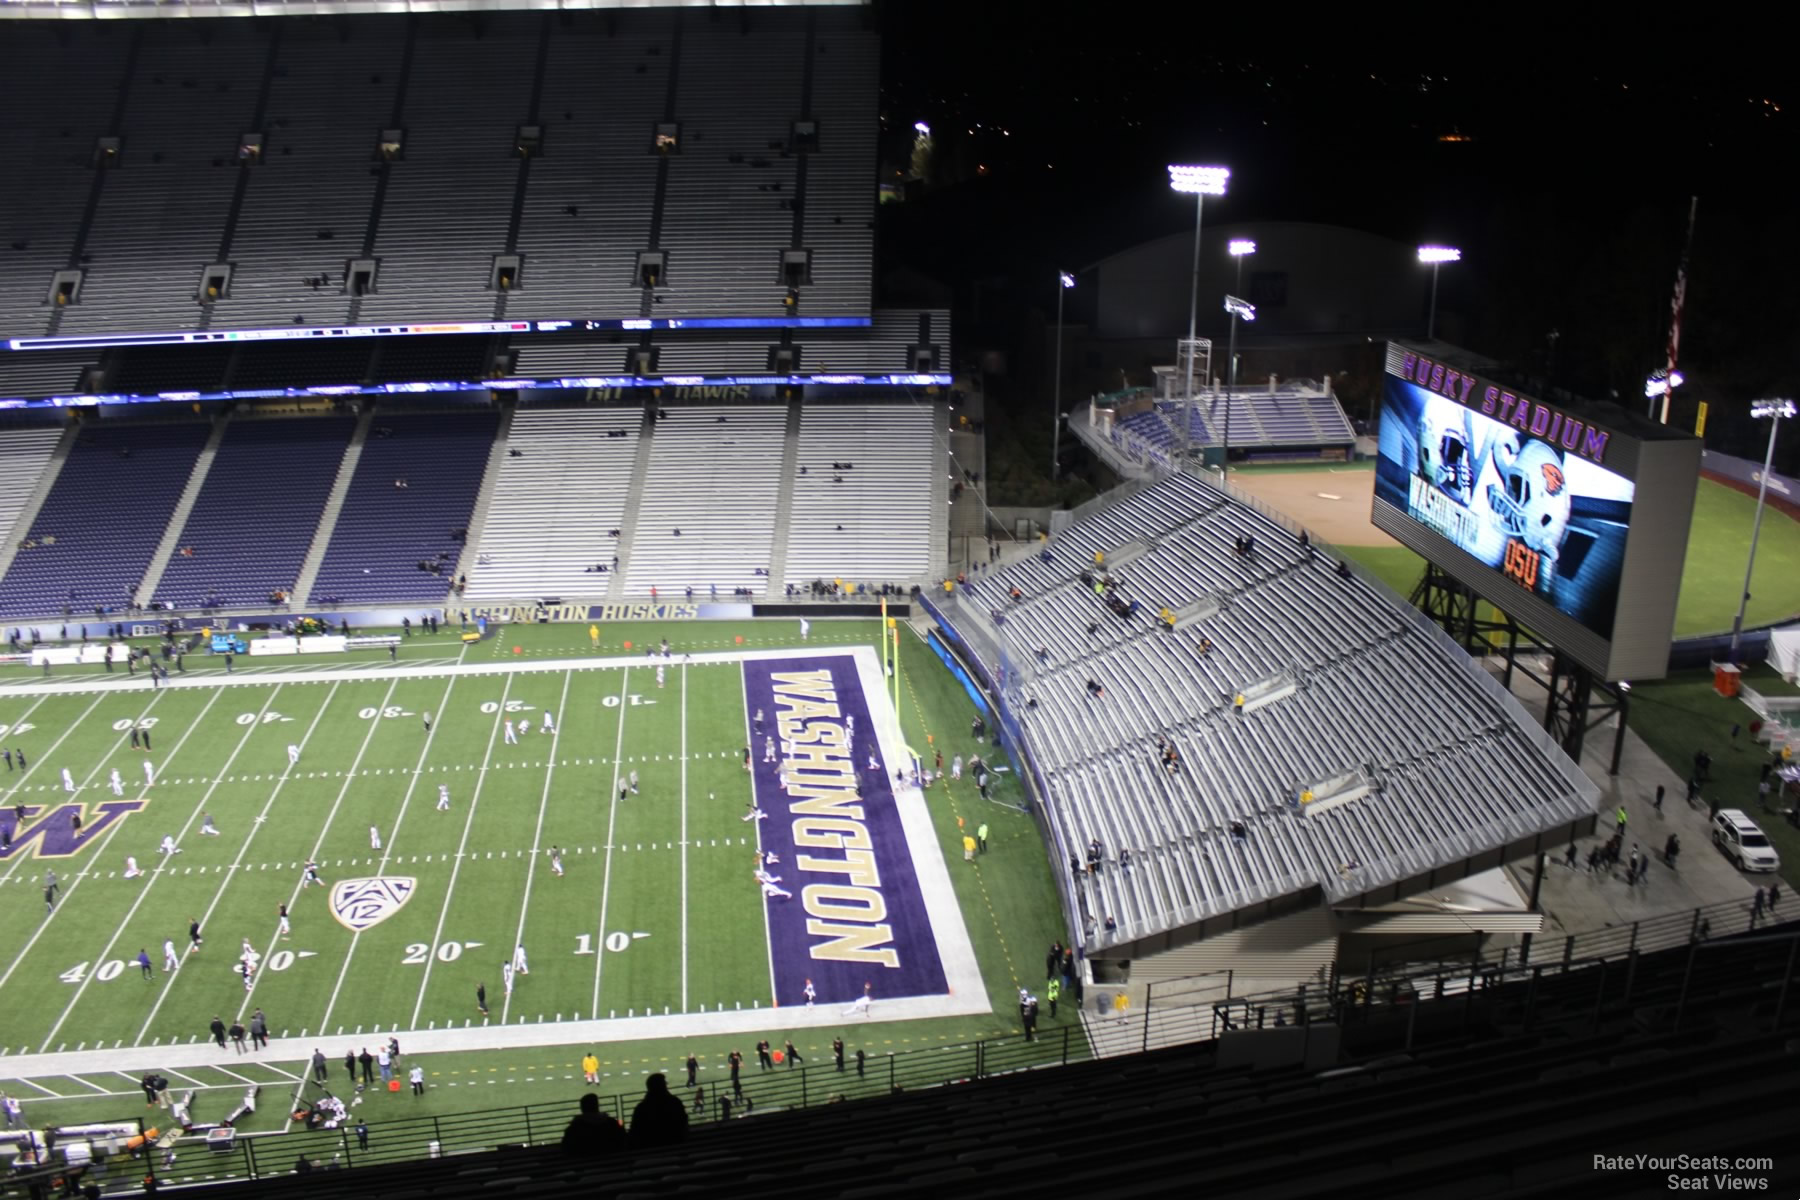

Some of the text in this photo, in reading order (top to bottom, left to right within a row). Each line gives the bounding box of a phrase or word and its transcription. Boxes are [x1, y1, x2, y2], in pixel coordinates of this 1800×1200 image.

[1402, 351, 1610, 463] HUSKY STADIUM
[1505, 538, 1540, 586] OSU
[602, 604, 699, 620] HUSKIES
[770, 669, 901, 967] WASHINGTON
[336, 879, 412, 906] PAC
[351, 904, 382, 919] 12
[401, 942, 462, 964] 20
[573, 931, 630, 955] 10
[59, 959, 125, 983] 40
